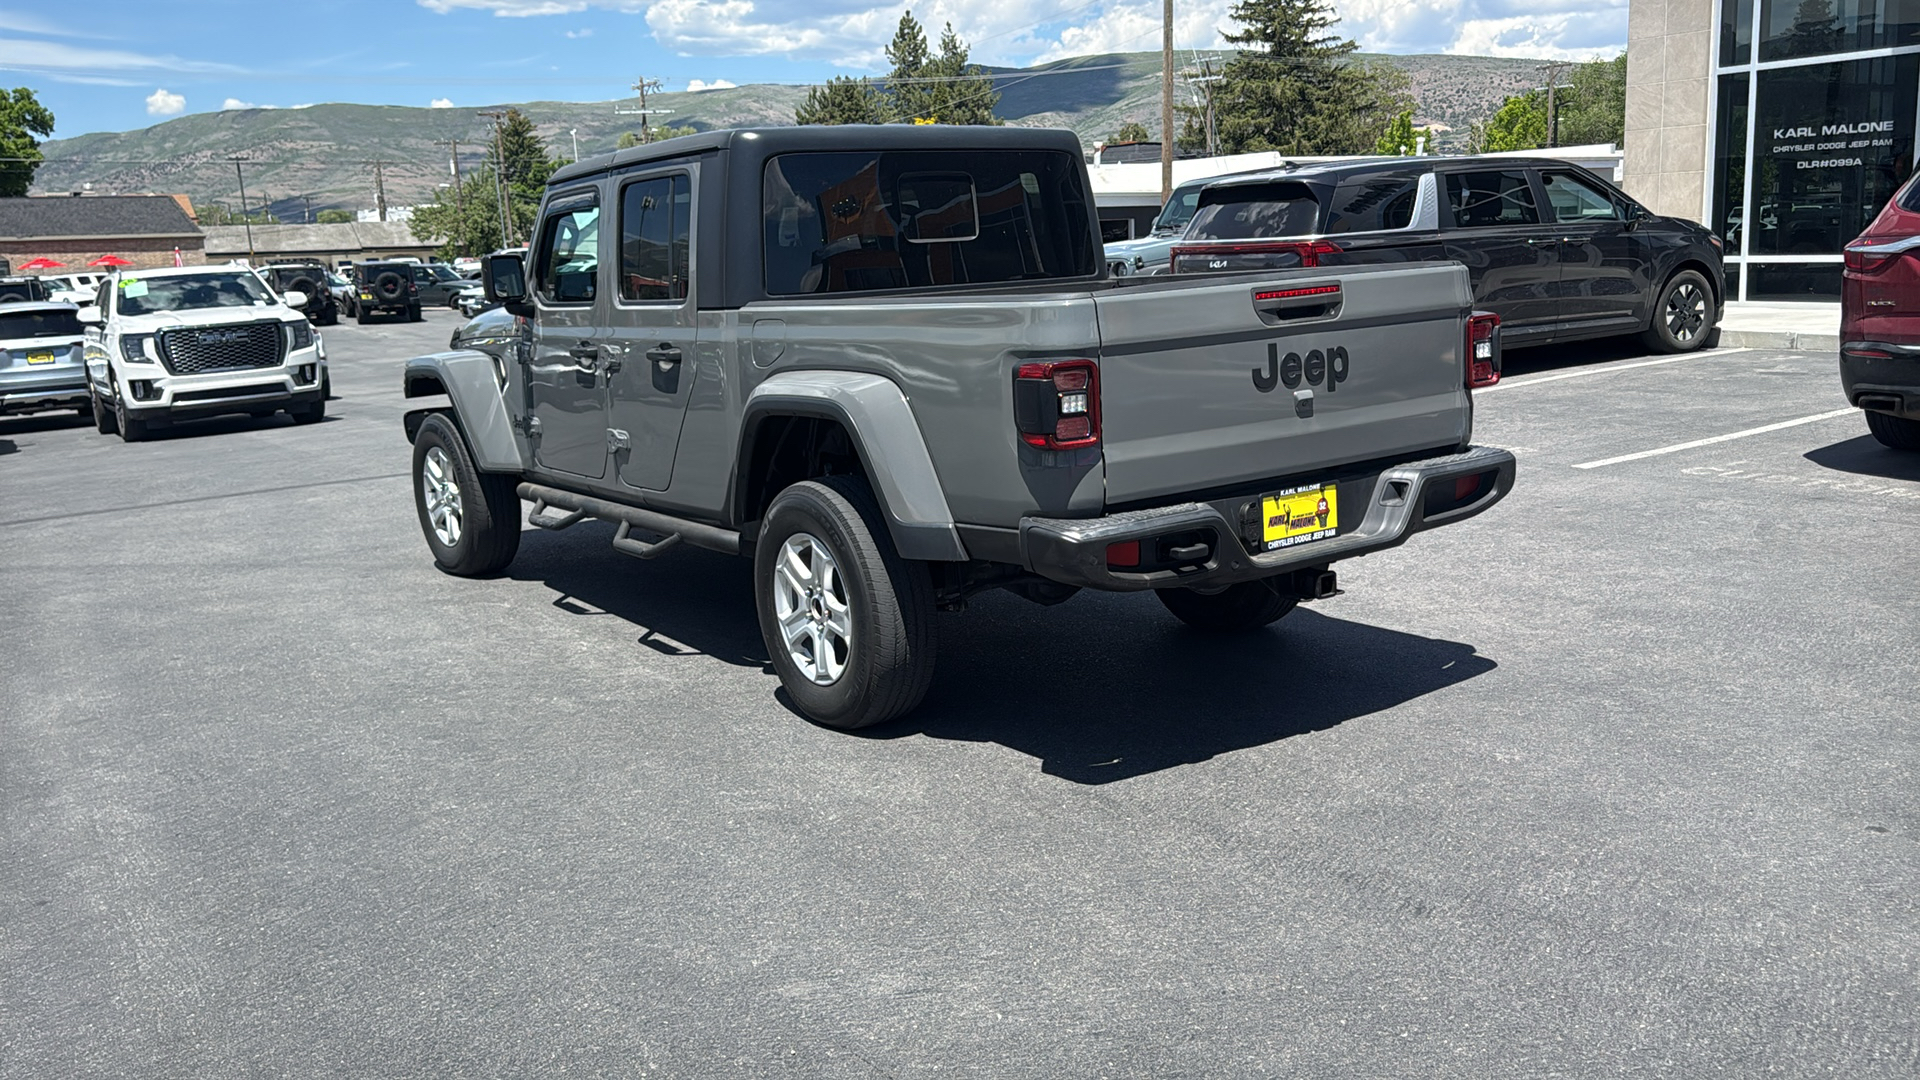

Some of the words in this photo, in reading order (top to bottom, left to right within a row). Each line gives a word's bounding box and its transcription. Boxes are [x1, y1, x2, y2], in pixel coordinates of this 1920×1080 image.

[1774, 126, 1817, 139] KARL
[1821, 120, 1894, 136] MALONE
[1773, 143, 1815, 153] CHRYSLER
[1817, 141, 1846, 151] DODGE
[1848, 140, 1870, 149] JEEP
[1872, 139, 1893, 147] RAM
[1796, 158, 1862, 169] DLR#099A
[1251, 342, 1349, 394] Jeep
[1280, 488, 1296, 496] KARL
[1297, 483, 1320, 492] MALONE
[1319, 501, 1327, 510] 32
[1268, 514, 1286, 528] KARL
[1290, 515, 1316, 531] MALONE
[1268, 537, 1294, 549] CHRYSLER
[1295, 533, 1312, 544] DODGE
[1313, 530, 1324, 540] JEEP
[1325, 528, 1336, 537] RAM
